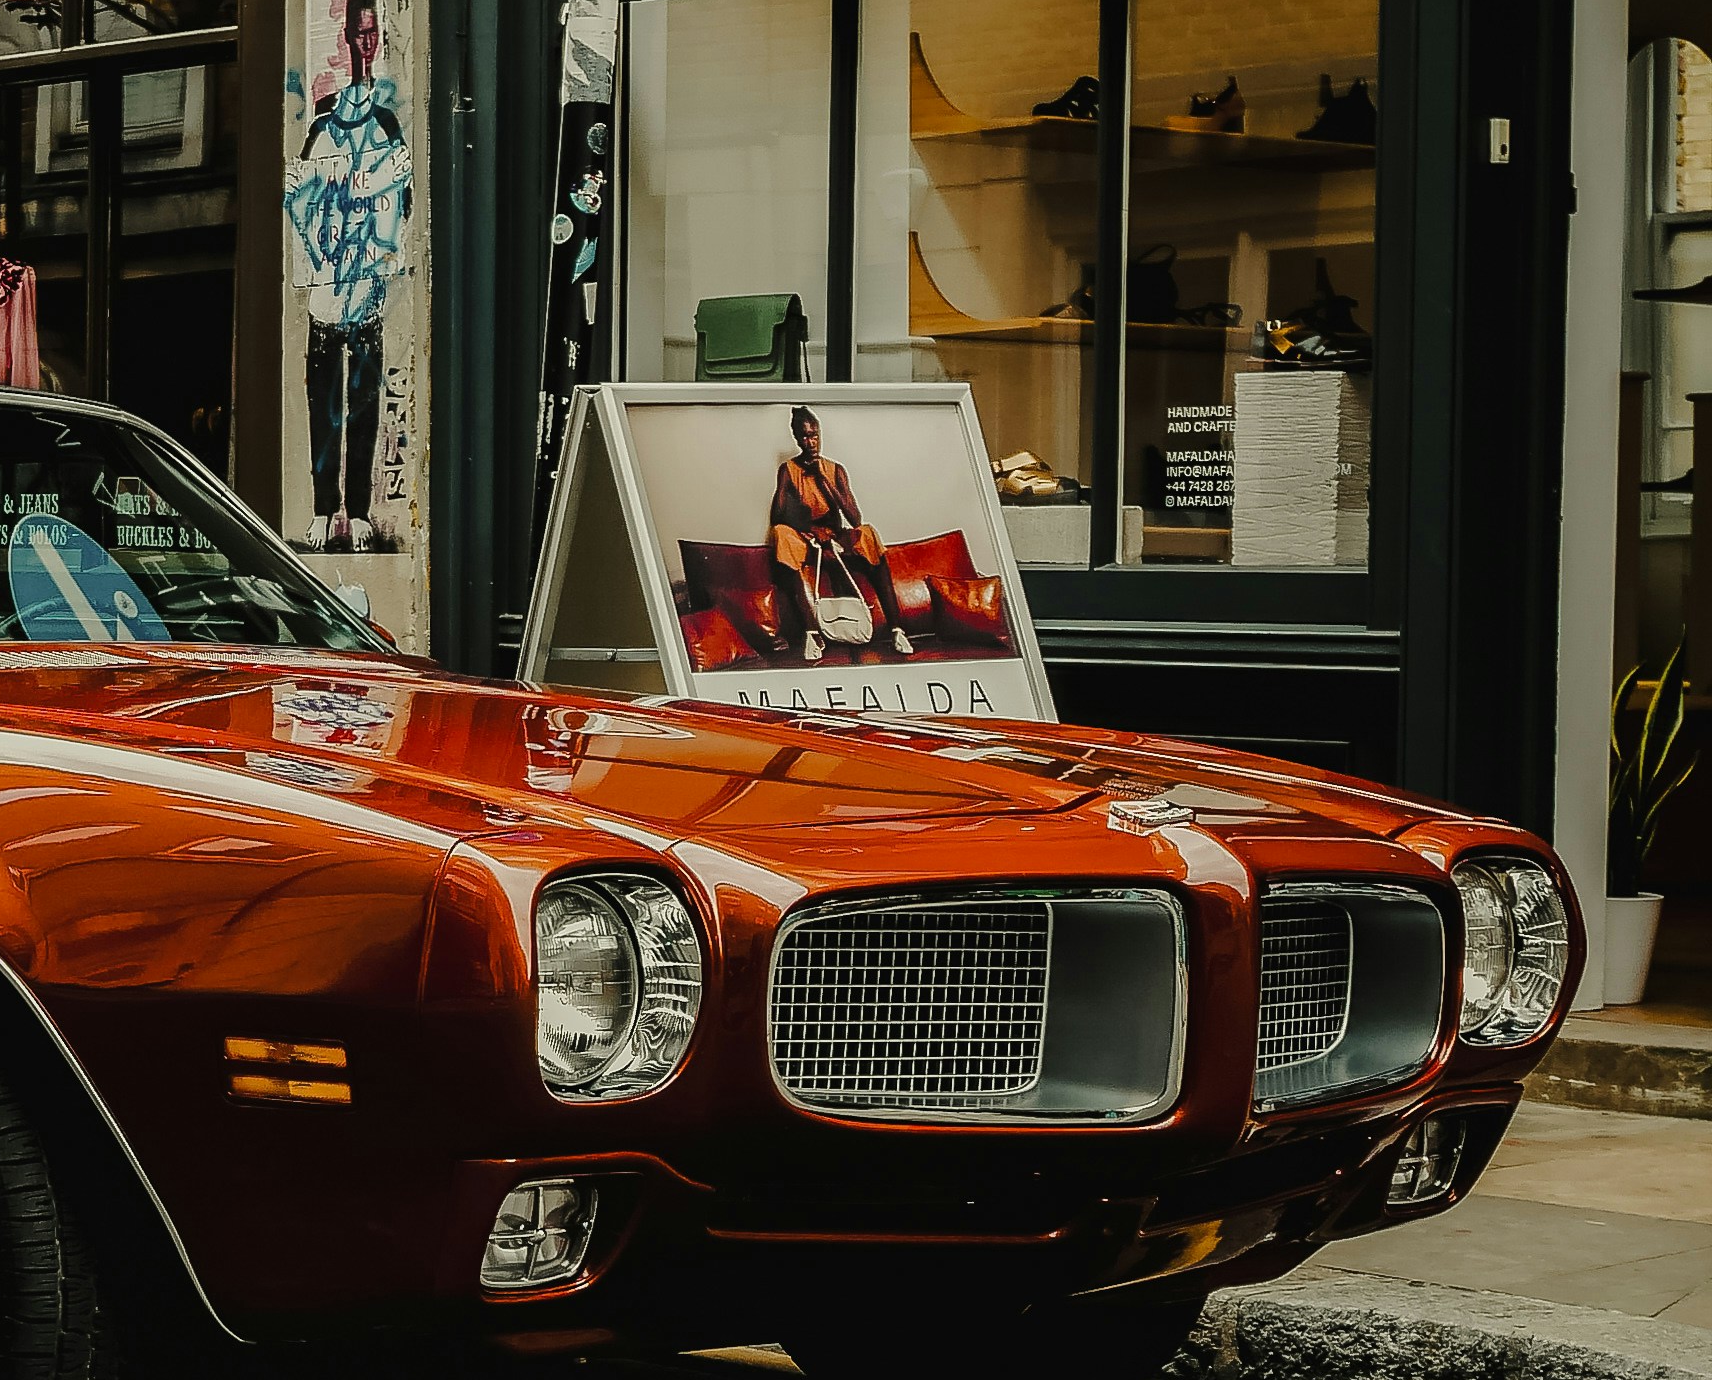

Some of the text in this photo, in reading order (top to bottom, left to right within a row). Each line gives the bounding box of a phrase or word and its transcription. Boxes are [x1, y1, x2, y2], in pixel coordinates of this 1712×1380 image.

[1167, 405, 1233, 418] HANDMADE
[1167, 420, 1192, 434] AND
[1165, 480, 1186, 493] +44
[1188, 480, 1214, 493] 7428
[3, 493, 15, 514] &
[18, 493, 60, 515] JEANS
[13, 524, 24, 546] &
[116, 525, 174, 548] BUCKLES
[178, 526, 191, 548] &
